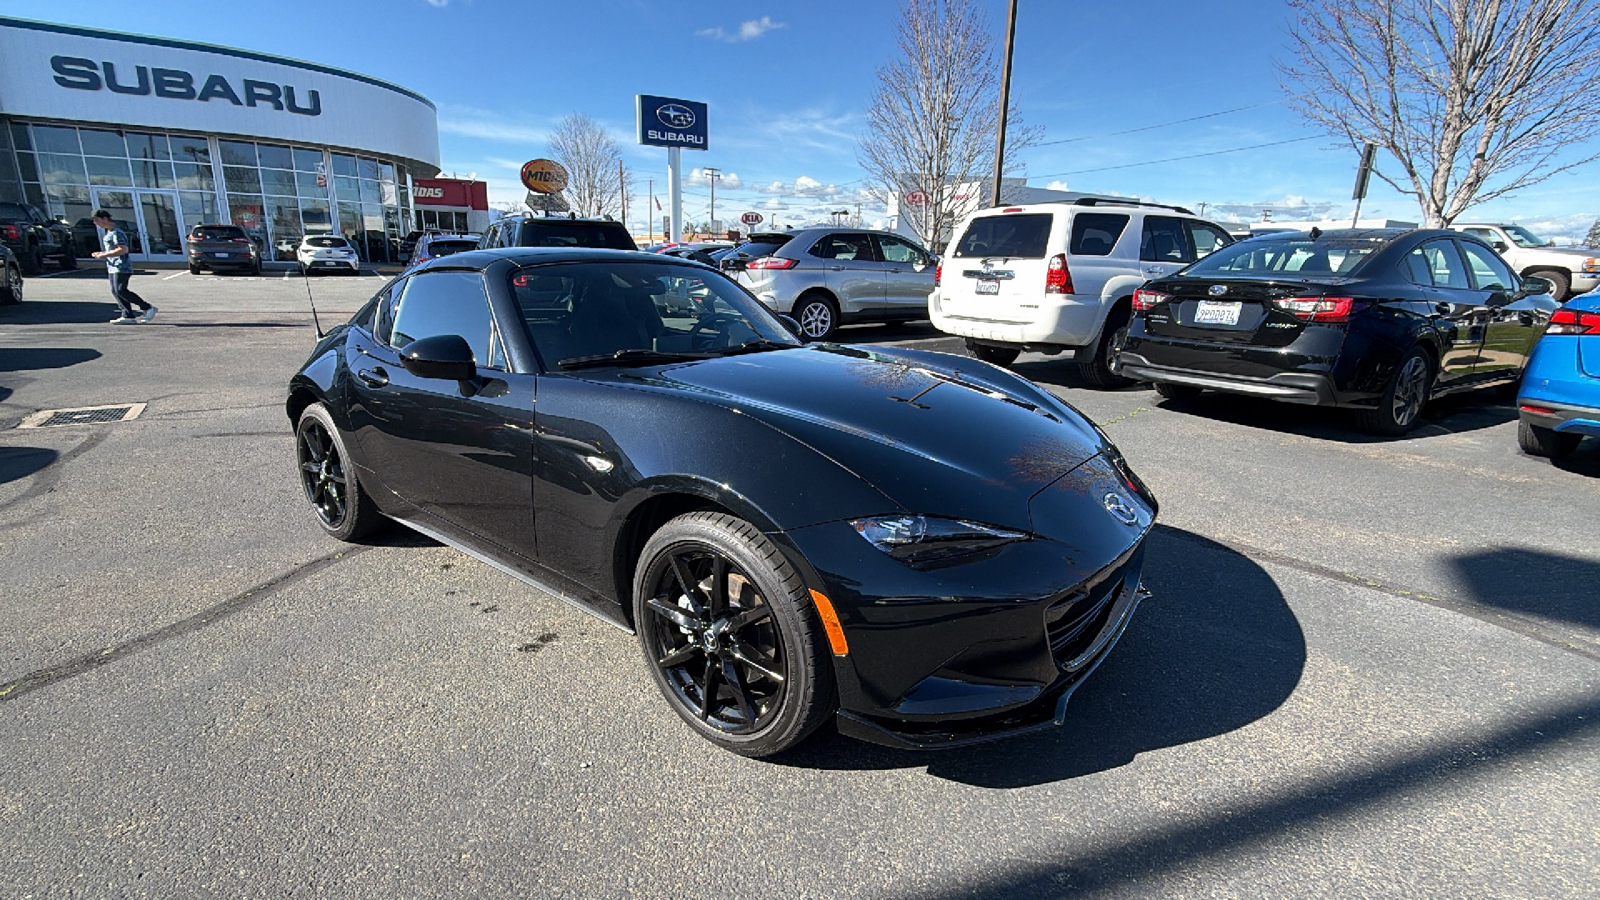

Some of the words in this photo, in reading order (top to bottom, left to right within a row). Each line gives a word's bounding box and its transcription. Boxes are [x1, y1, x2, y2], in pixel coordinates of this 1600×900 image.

[49, 54, 322, 117] SUBARU
[647, 129, 704, 145] SUBARU
[412, 182, 444, 198] IDAS
[745, 214, 760, 223] KIA
